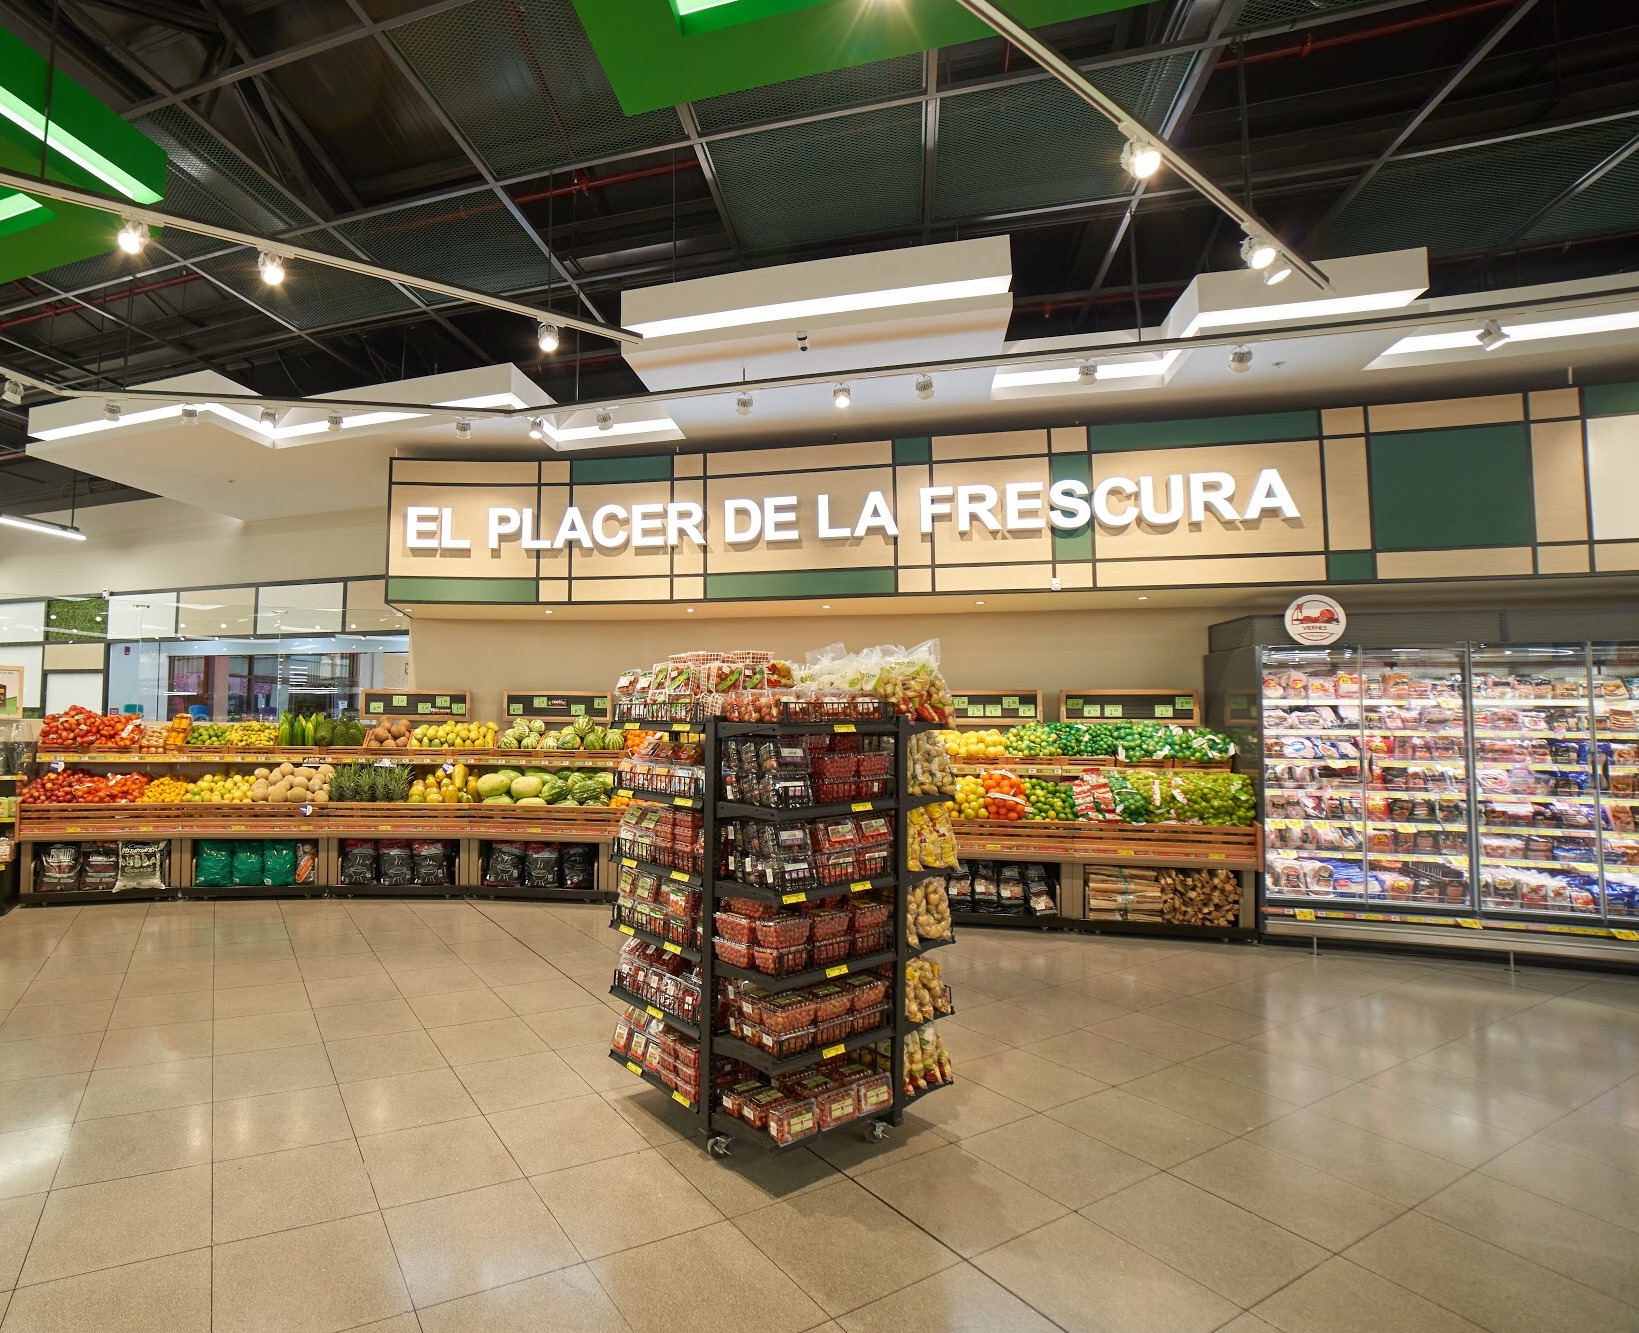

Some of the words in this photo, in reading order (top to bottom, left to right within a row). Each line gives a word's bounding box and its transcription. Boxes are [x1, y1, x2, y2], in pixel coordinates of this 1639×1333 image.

[406, 507, 470, 549] EL
[488, 502, 707, 550] PLACER
[724, 495, 799, 545] DE
[817, 490, 899, 540] LA
[919, 469, 1301, 534] FRESCURA
